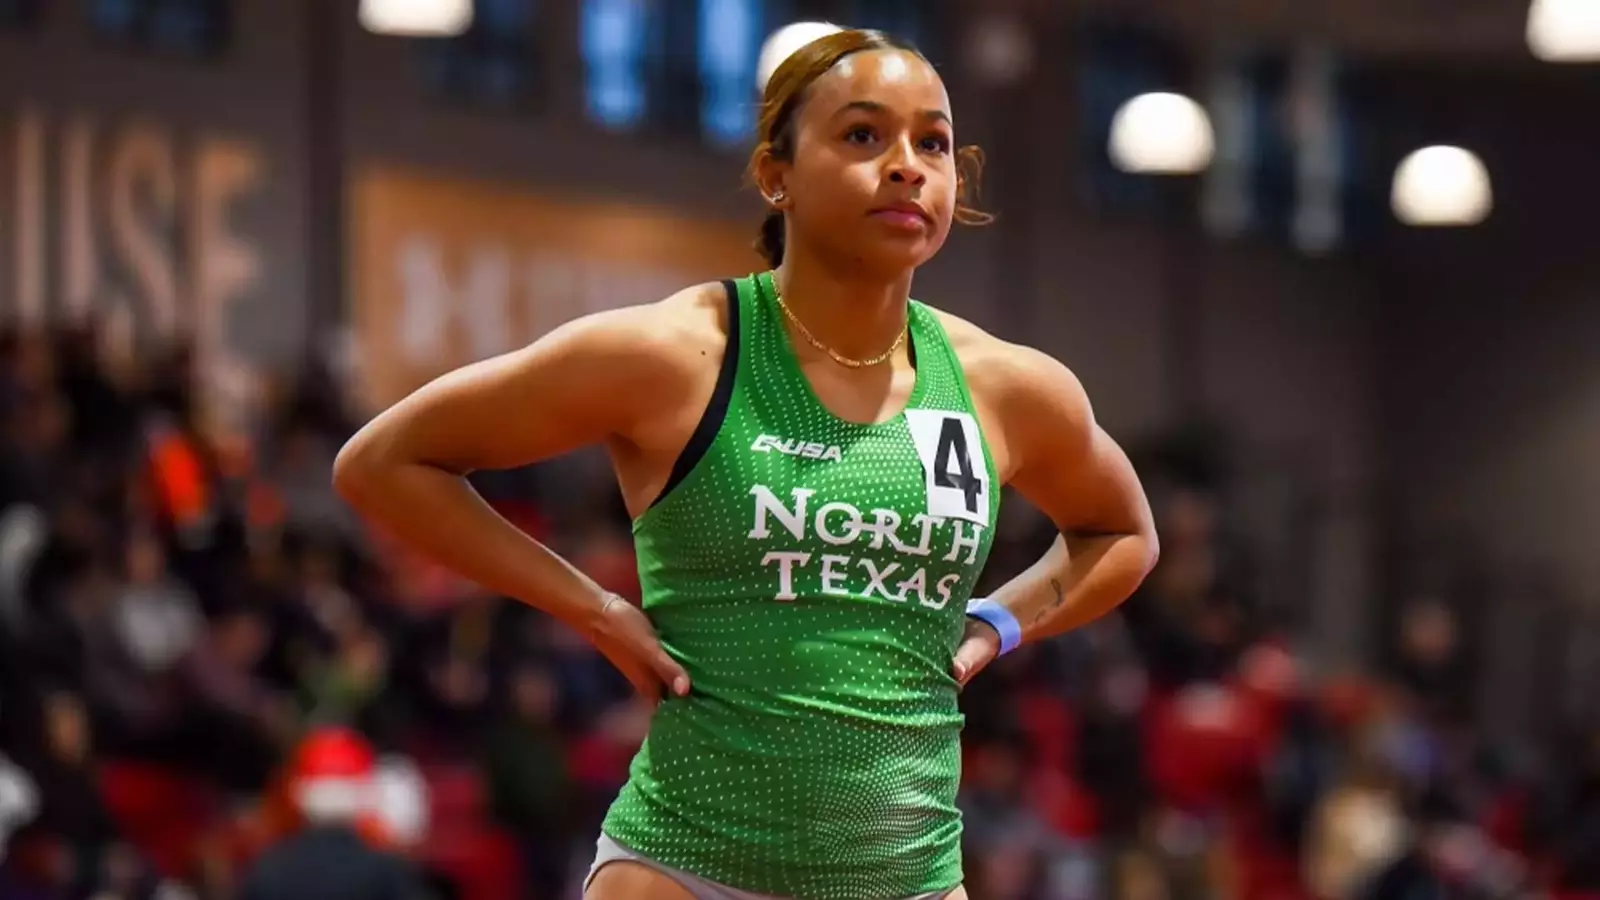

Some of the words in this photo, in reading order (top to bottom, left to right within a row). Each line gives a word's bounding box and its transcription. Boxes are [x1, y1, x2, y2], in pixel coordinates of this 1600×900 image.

[933, 417, 982, 514] 4
[748, 484, 984, 565] NORTH
[760, 551, 960, 609] TEXAS
